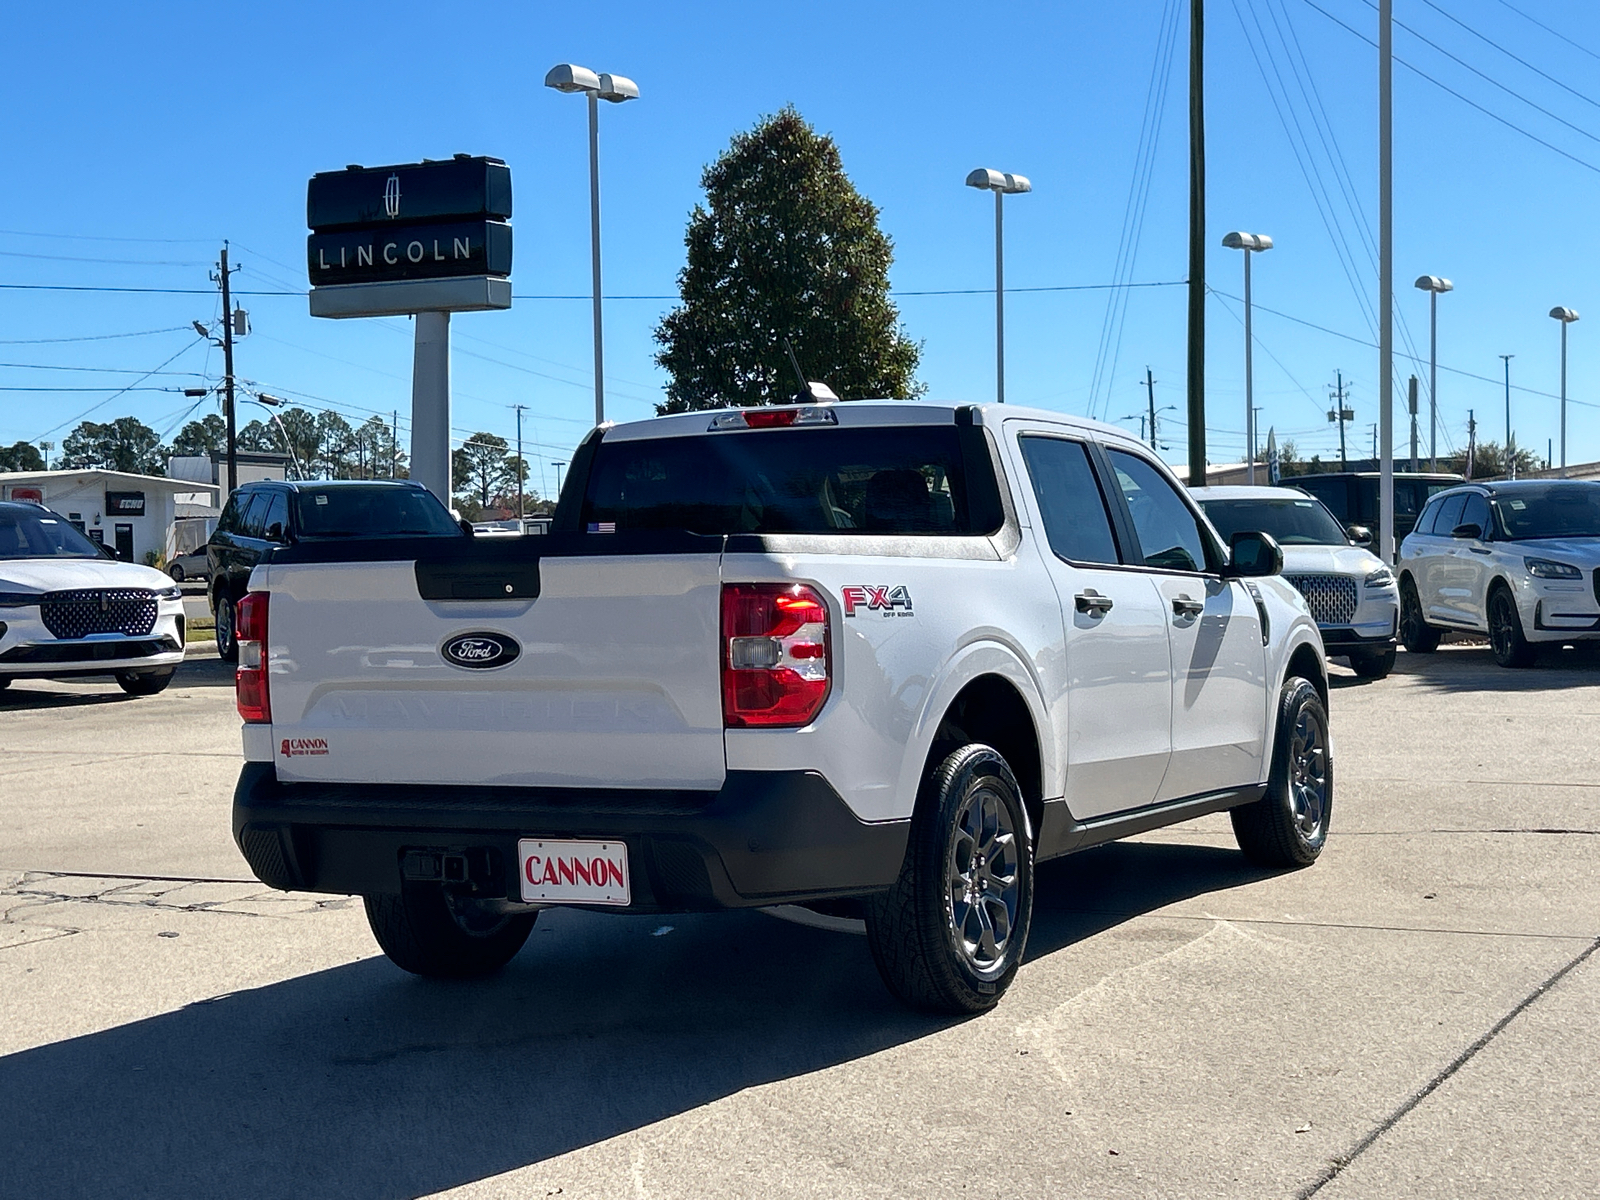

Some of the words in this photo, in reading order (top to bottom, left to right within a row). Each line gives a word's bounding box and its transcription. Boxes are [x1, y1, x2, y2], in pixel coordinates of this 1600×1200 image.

[319, 237, 470, 269] LINCOLN
[119, 499, 144, 509] ECHO
[840, 585, 913, 618] FX4
[458, 641, 492, 658] Ford
[291, 738, 328, 749] CANNON
[525, 855, 624, 888] CANNON
